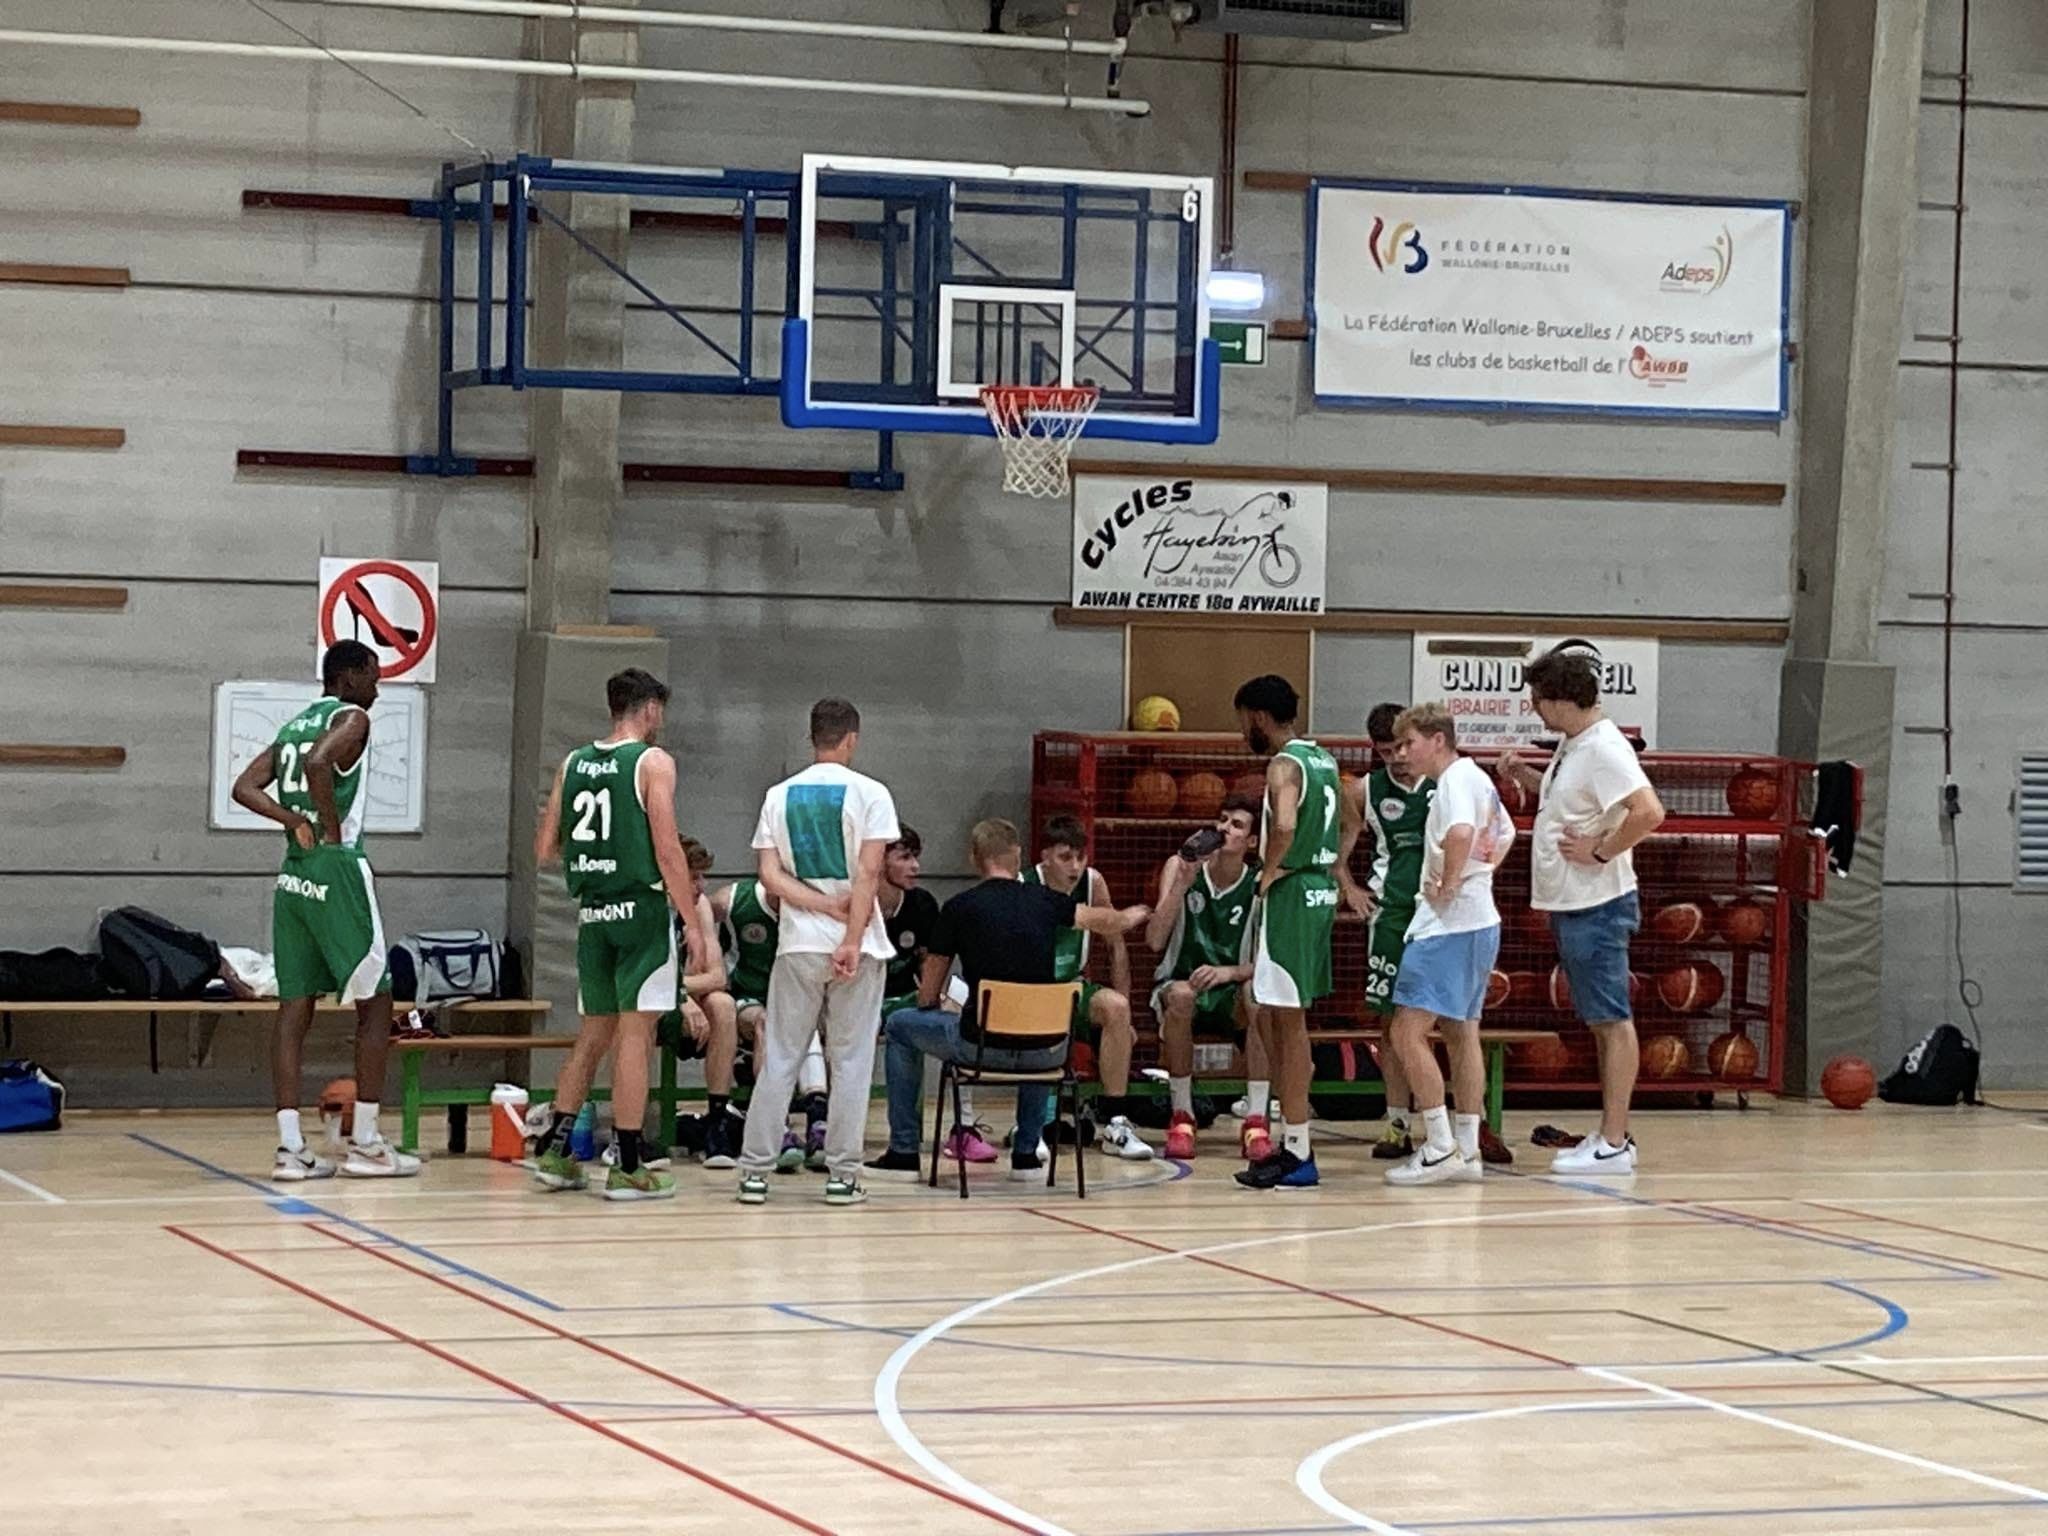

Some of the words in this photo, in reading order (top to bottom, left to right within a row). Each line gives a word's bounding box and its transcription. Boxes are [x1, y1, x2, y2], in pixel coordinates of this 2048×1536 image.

[1441, 238, 1570, 256] FÉDÉRATION
[1661, 262, 1714, 284] Adeps
[1344, 315, 1363, 330] La
[1368, 314, 1457, 333] Fédération
[1630, 325, 1684, 343] ADEPS
[1690, 330, 1754, 345] soutient
[1410, 349, 1431, 367] les
[1436, 351, 1477, 369] clubs
[1482, 352, 1502, 369] de
[1508, 352, 1588, 374] basketball
[1593, 356, 1612, 374] de
[1080, 591, 1131, 607] AWAN
[1136, 593, 1200, 609] CENTRE
[1238, 595, 1320, 612] AYWAILLE
[1441, 660, 1502, 692] CLIN
[1598, 663, 1636, 694] EIL
[1446, 699, 1511, 716] IBRAIRIE
[571, 788, 612, 841] 21
[1366, 973, 1389, 996] 26
